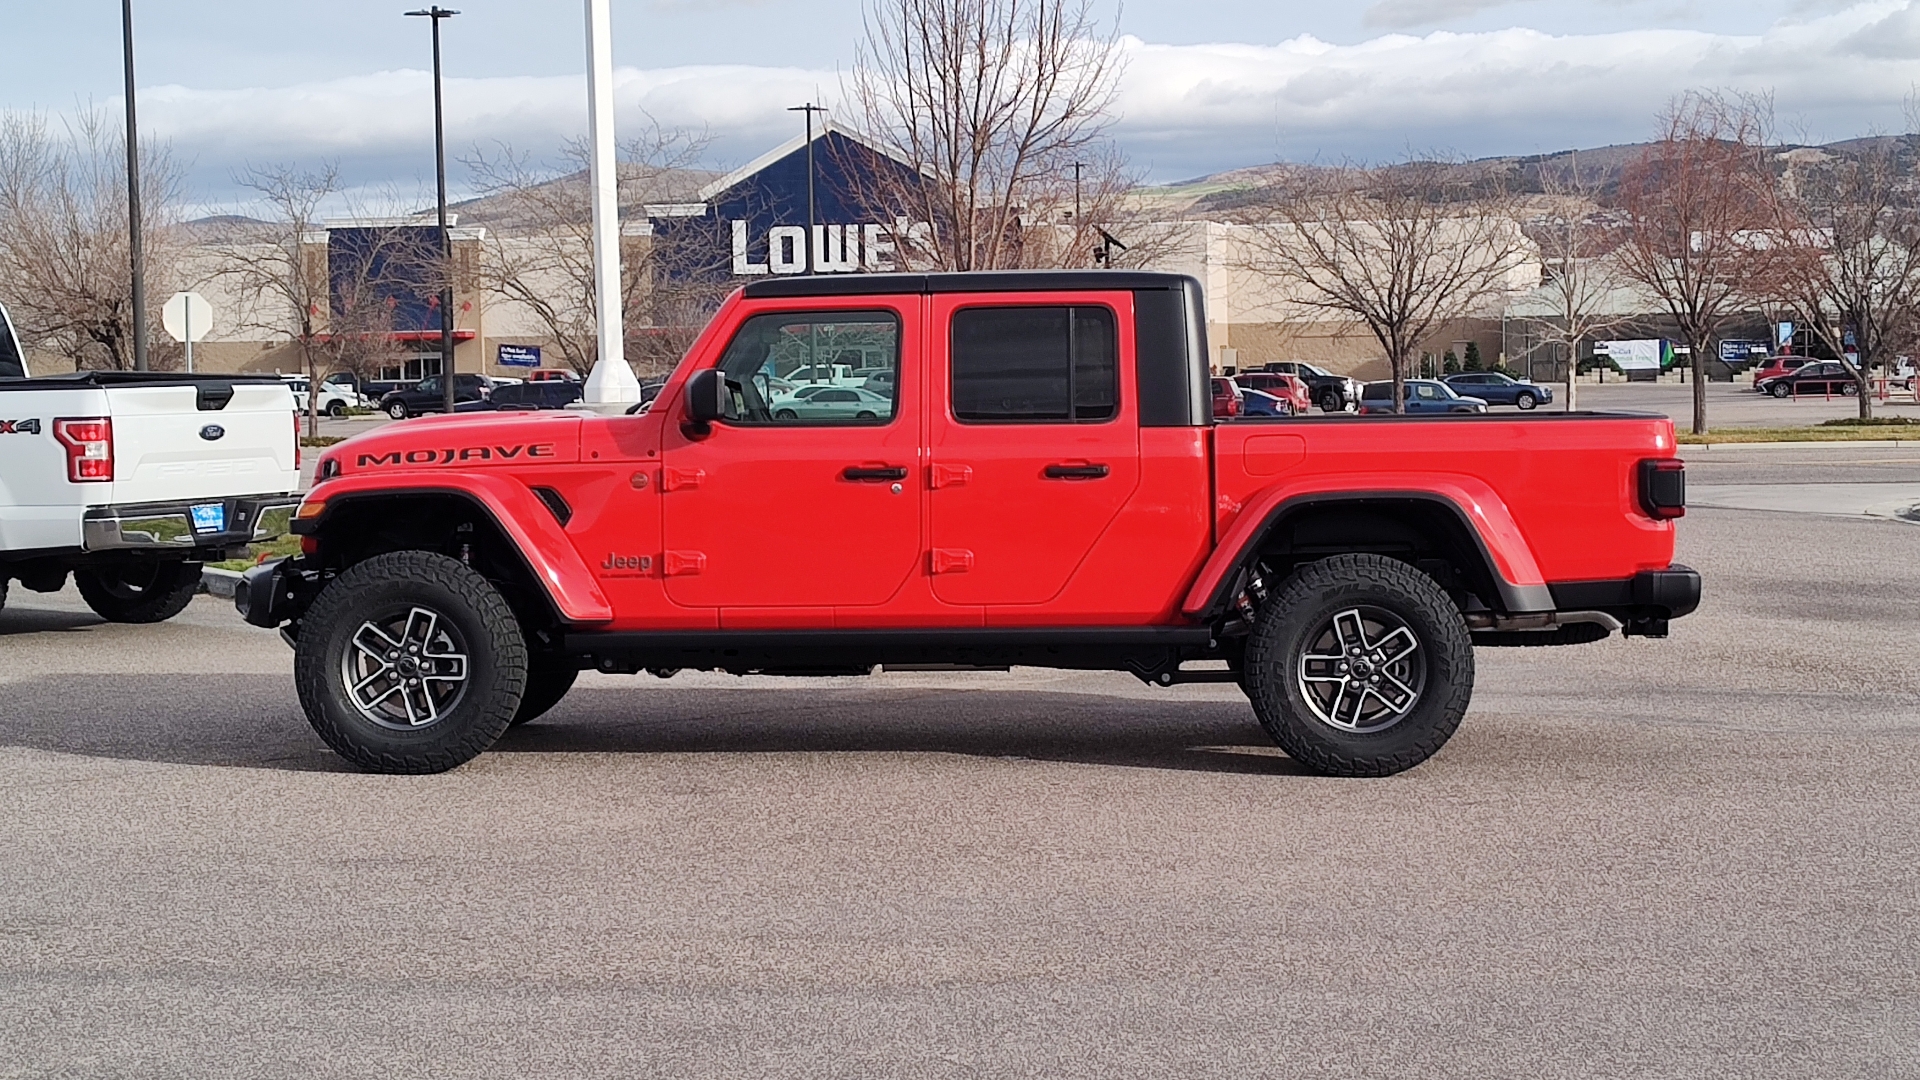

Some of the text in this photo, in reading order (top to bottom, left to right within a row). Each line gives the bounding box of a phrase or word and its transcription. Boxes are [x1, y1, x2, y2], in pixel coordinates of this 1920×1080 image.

[731, 216, 939, 275] LOWE'S
[356, 442, 555, 467] MOJAVE
[601, 552, 653, 572] Jeep
